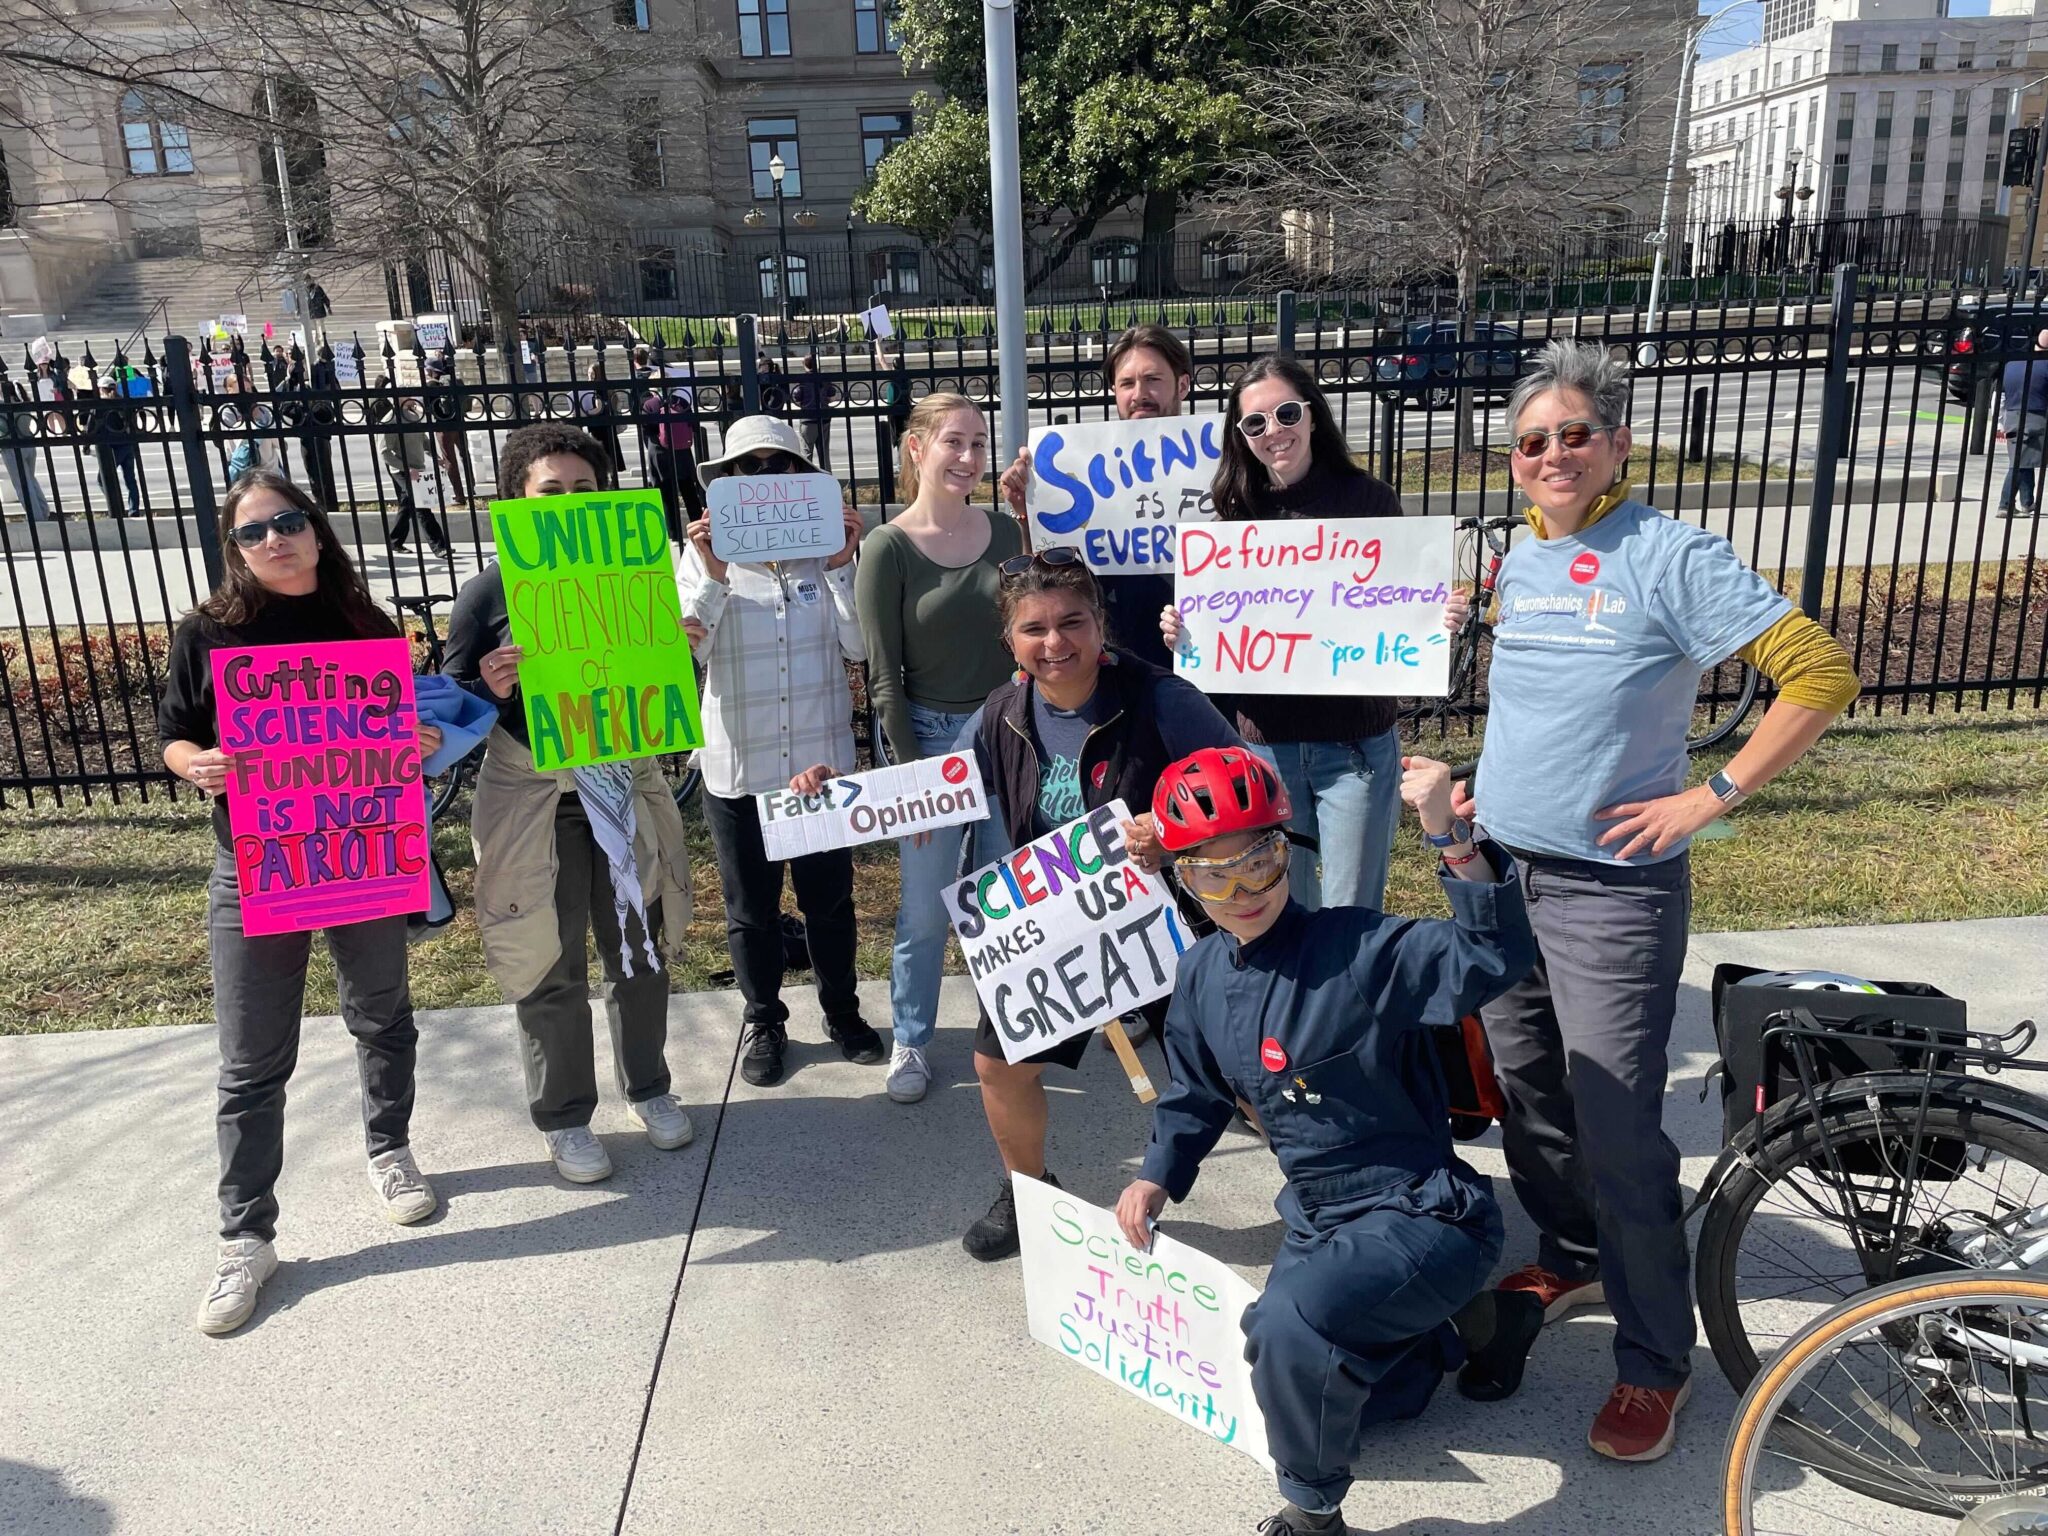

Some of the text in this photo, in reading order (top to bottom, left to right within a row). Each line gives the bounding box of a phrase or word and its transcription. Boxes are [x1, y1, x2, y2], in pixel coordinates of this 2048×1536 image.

[720, 501, 823, 525] SILENCE
[738, 480, 816, 503] DON'T
[1136, 488, 1215, 519] IS FO
[497, 501, 668, 571] UNITED
[727, 528, 822, 552] SCIENCE
[1085, 525, 1176, 566] EVER
[1181, 524, 1382, 583] Defunding
[513, 571, 680, 658] SCIENTISTS
[1179, 580, 1449, 623] pregnancy research
[1513, 593, 1626, 614] Neuromechanics Lab
[581, 650, 614, 689] of
[1180, 645, 1201, 669] is
[1215, 625, 1312, 674] NOT
[223, 655, 402, 718] Cutting
[225, 703, 414, 748] SCIENCE
[530, 684, 696, 767] AMERICA
[234, 746, 421, 796] FUNDING
[257, 786, 403, 832] is NOT
[763, 783, 836, 821] Fact
[850, 786, 977, 835] Opinion
[234, 823, 426, 897] PATRIOTIC
[957, 804, 1128, 939] SCIENCE
[969, 866, 1149, 981] MAKES USA
[1051, 1200, 1219, 1312] Science
[1088, 1264, 1190, 1345] Truth
[1074, 1291, 1222, 1389] Justice
[1059, 1312, 1236, 1443] Solidarity
